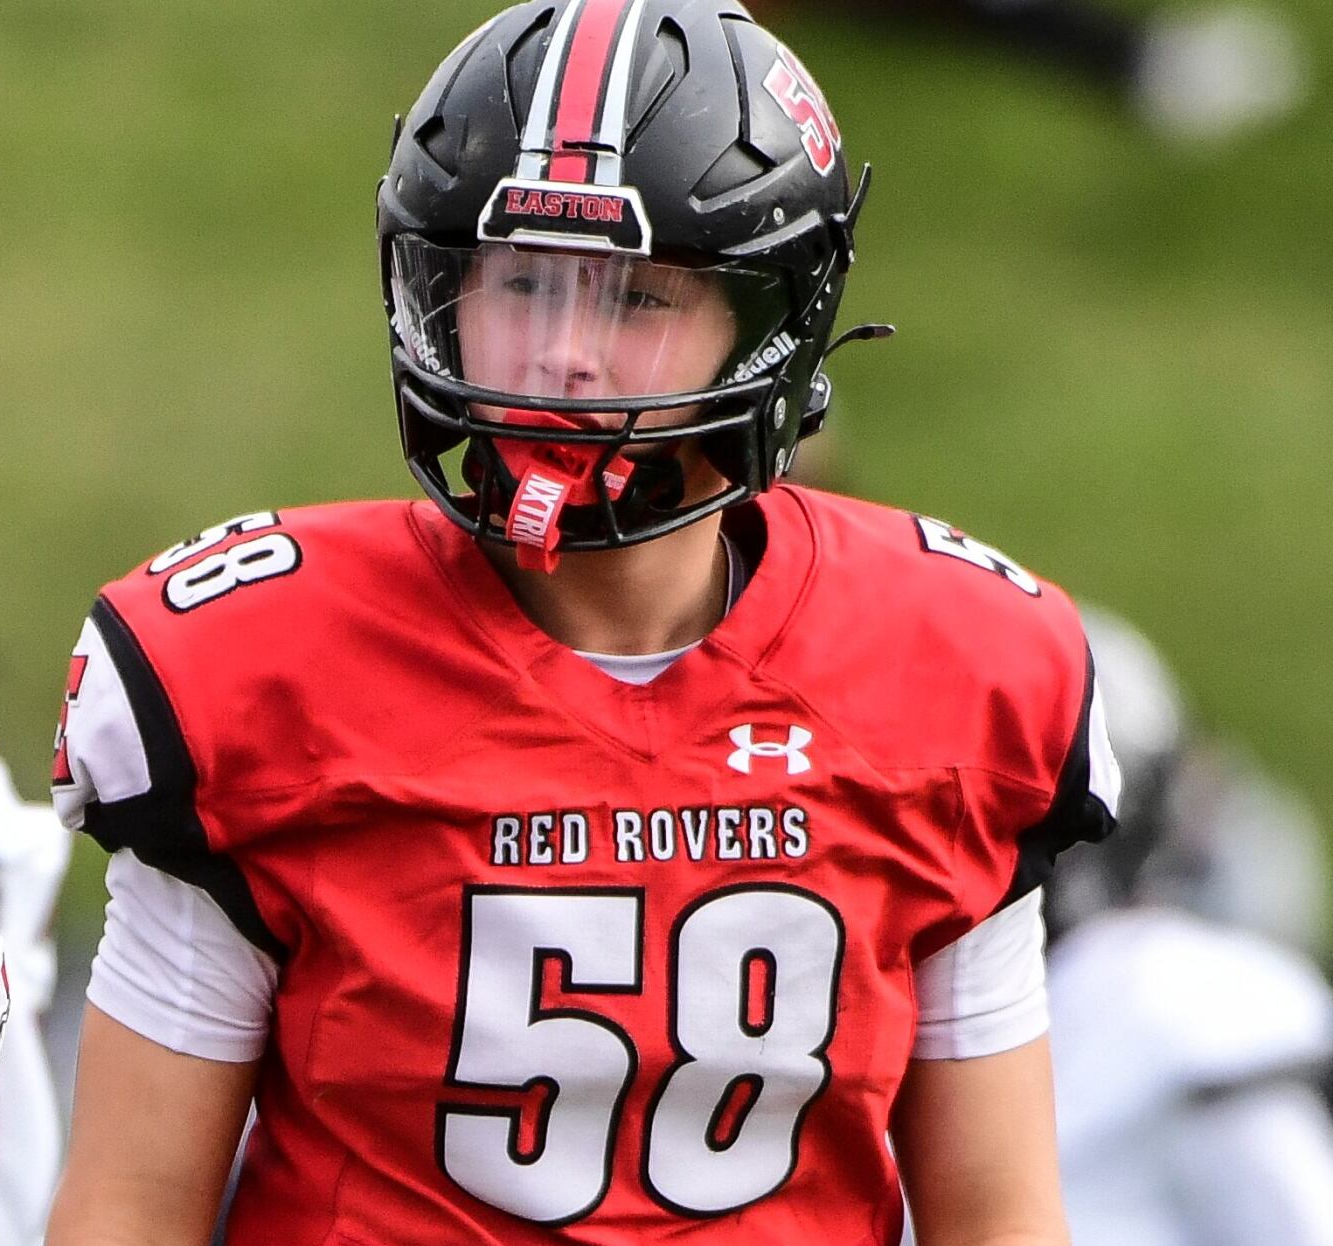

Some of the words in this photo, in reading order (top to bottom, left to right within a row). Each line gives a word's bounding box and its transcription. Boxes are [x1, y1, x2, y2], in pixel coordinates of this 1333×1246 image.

[762, 43, 841, 178] 5
[506, 189, 624, 223] EASTON
[145, 509, 303, 615] 58
[913, 513, 1041, 597] 5
[490, 810, 588, 868] RED
[614, 806, 808, 863] ROVERS
[436, 885, 844, 1228] 58
